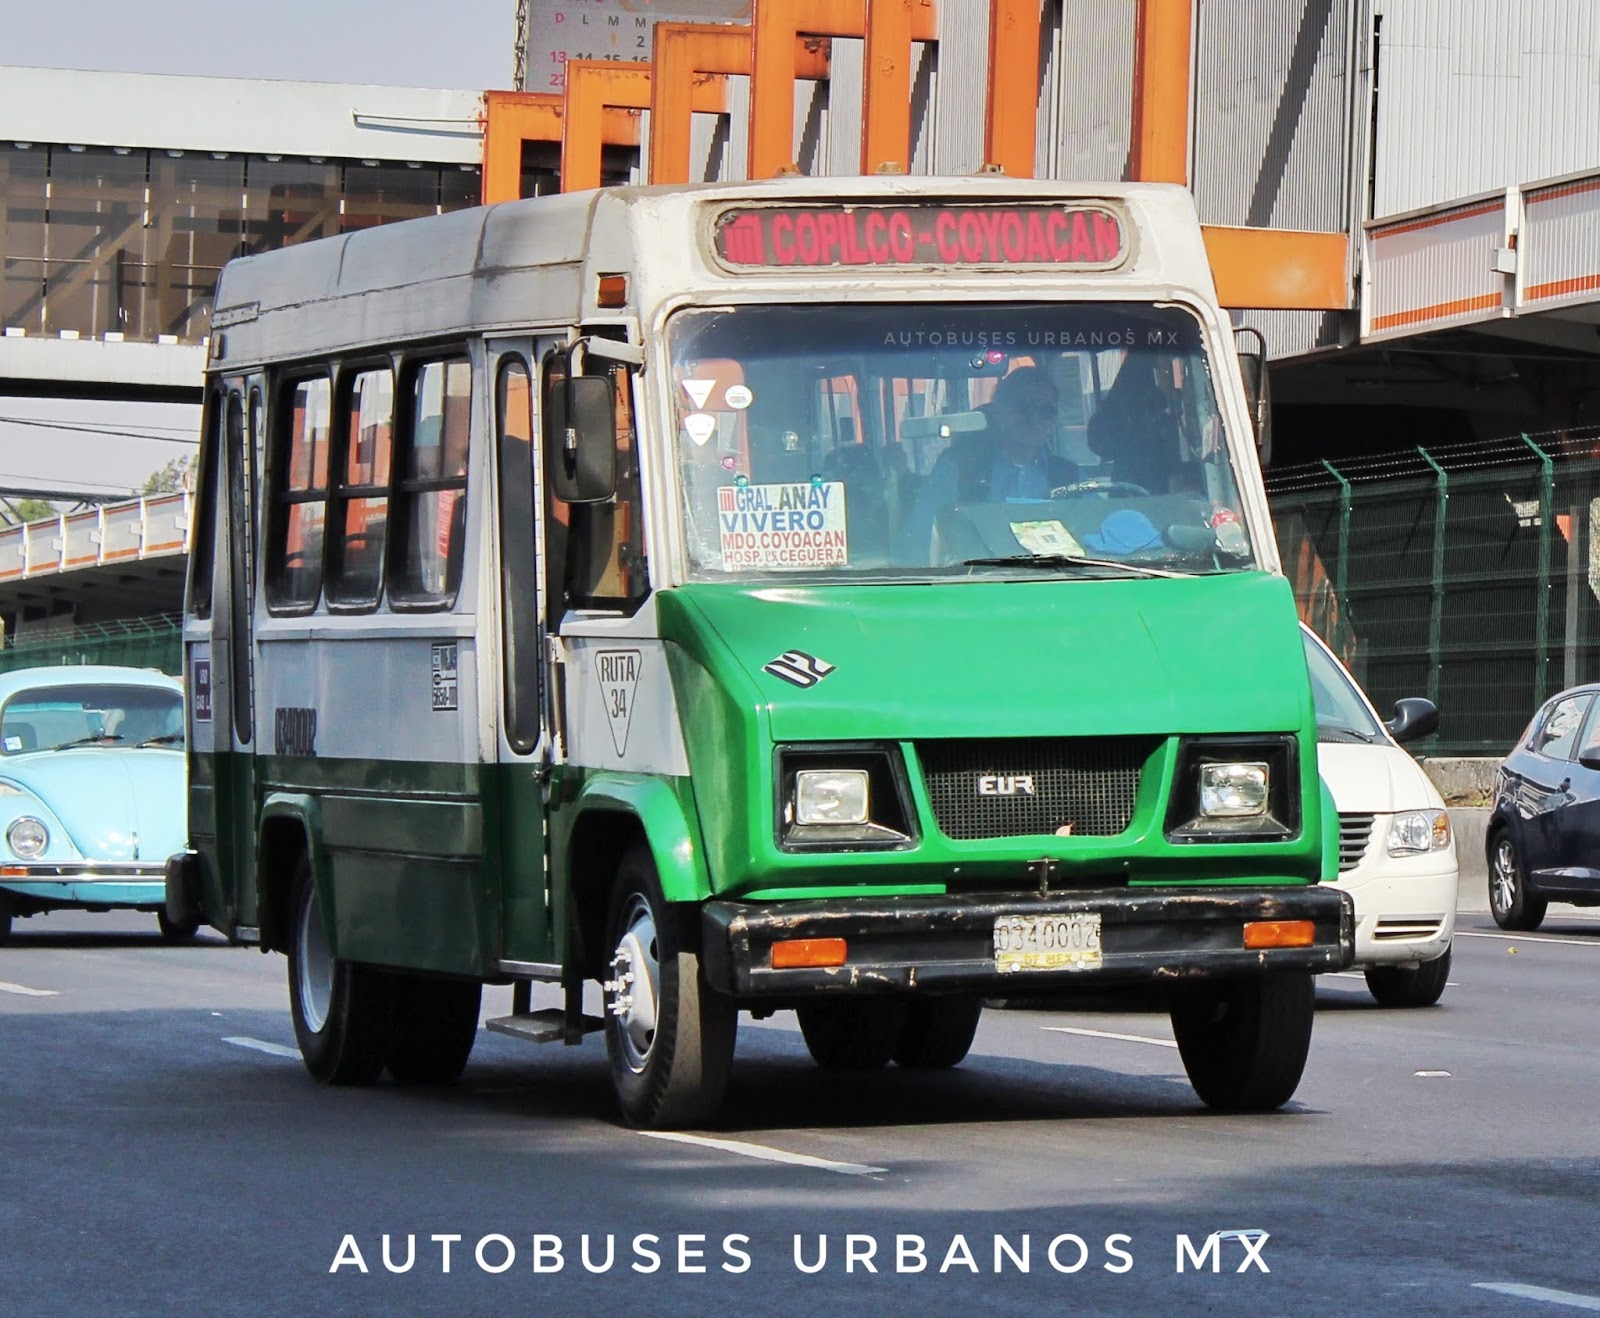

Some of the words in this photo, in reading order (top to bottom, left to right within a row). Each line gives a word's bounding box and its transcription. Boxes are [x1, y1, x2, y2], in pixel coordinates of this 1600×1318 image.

[555, 12, 565, 23] D
[582, 14, 589, 25] L
[608, 16, 619, 26] M
[635, 17, 646, 28] M
[637, 35, 645, 48] 2
[721, 510, 825, 533] VIVERO
[780, 548, 845, 562] CEGUERA
[601, 655, 635, 683] RUTA
[764, 649, 837, 689] 02
[611, 688, 627, 719] 34
[979, 775, 1036, 796] EUR
